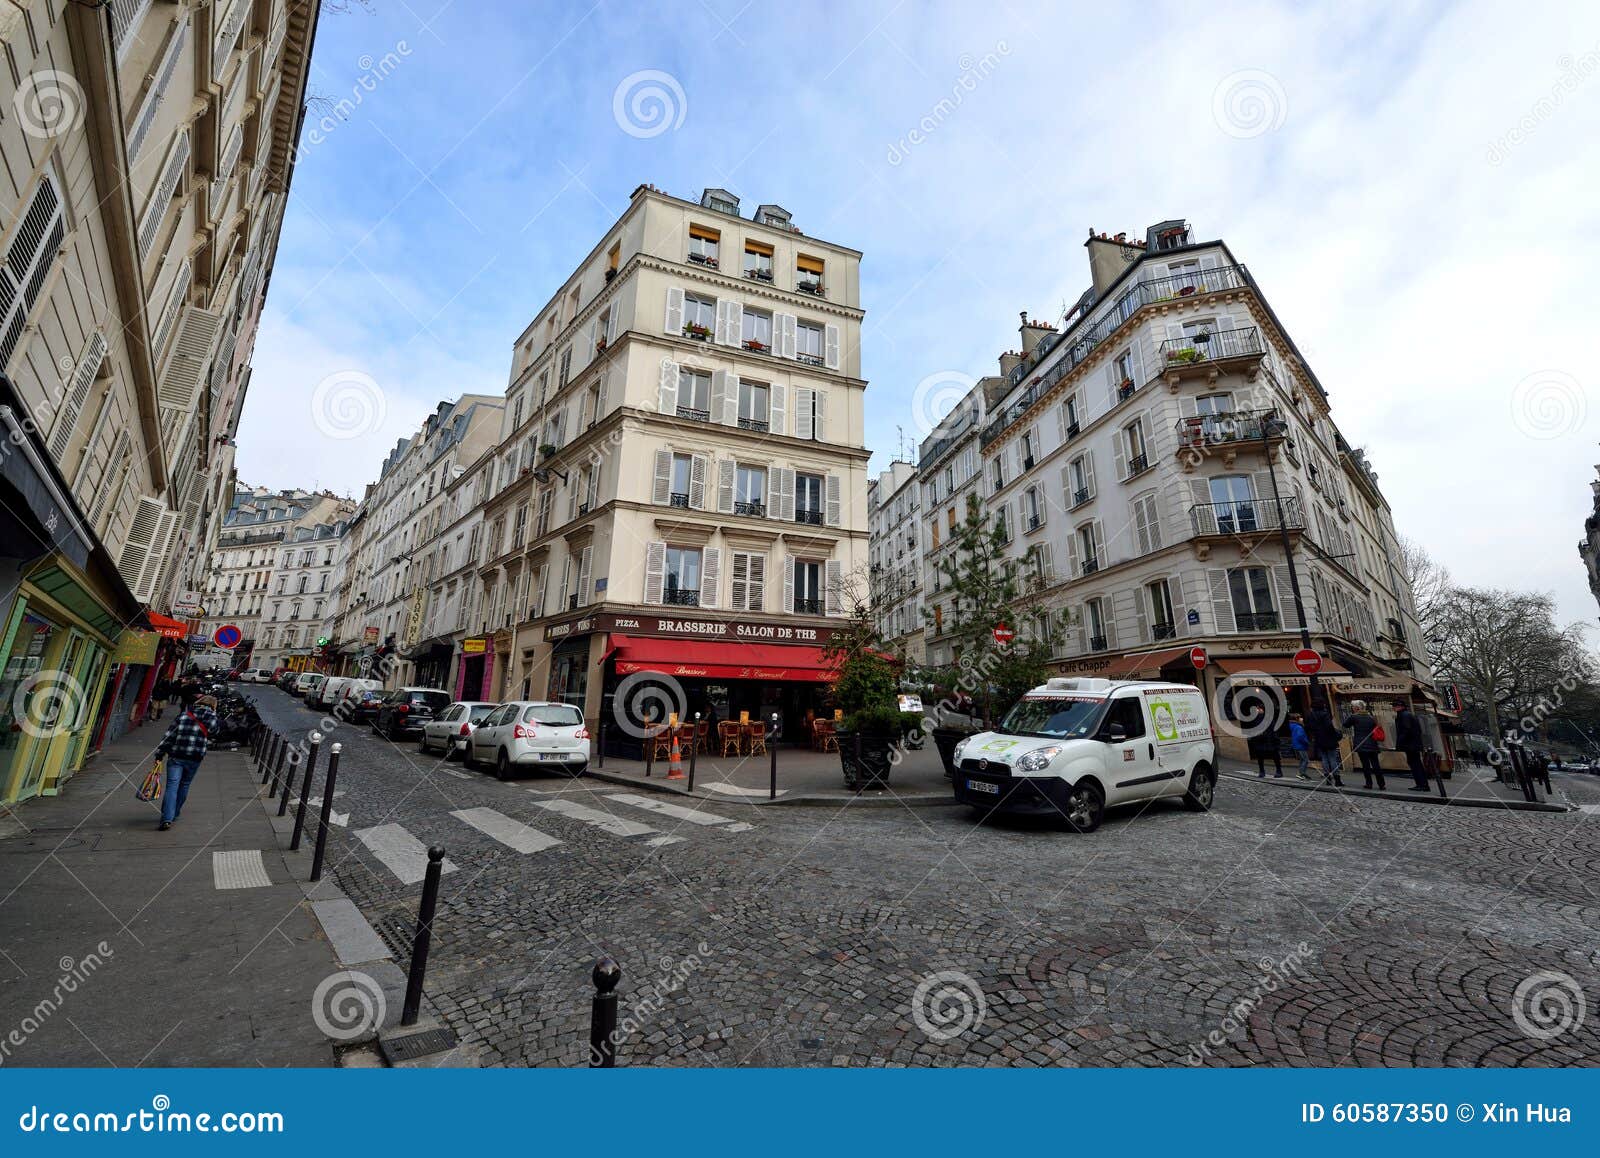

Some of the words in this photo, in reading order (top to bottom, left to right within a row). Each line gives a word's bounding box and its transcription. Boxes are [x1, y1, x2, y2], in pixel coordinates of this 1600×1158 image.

[615, 619, 640, 628] PIZZA
[658, 620, 727, 635] BRASSERIE
[736, 624, 775, 638] SALON
[777, 627, 793, 639] DE
[795, 628, 817, 640] THE
[674, 665, 707, 676] Brasserie
[1060, 662, 1077, 673] Café
[1273, 676, 1337, 686] Restauant
[1336, 682, 1360, 692] Café
[1361, 682, 1406, 692] Chappe
